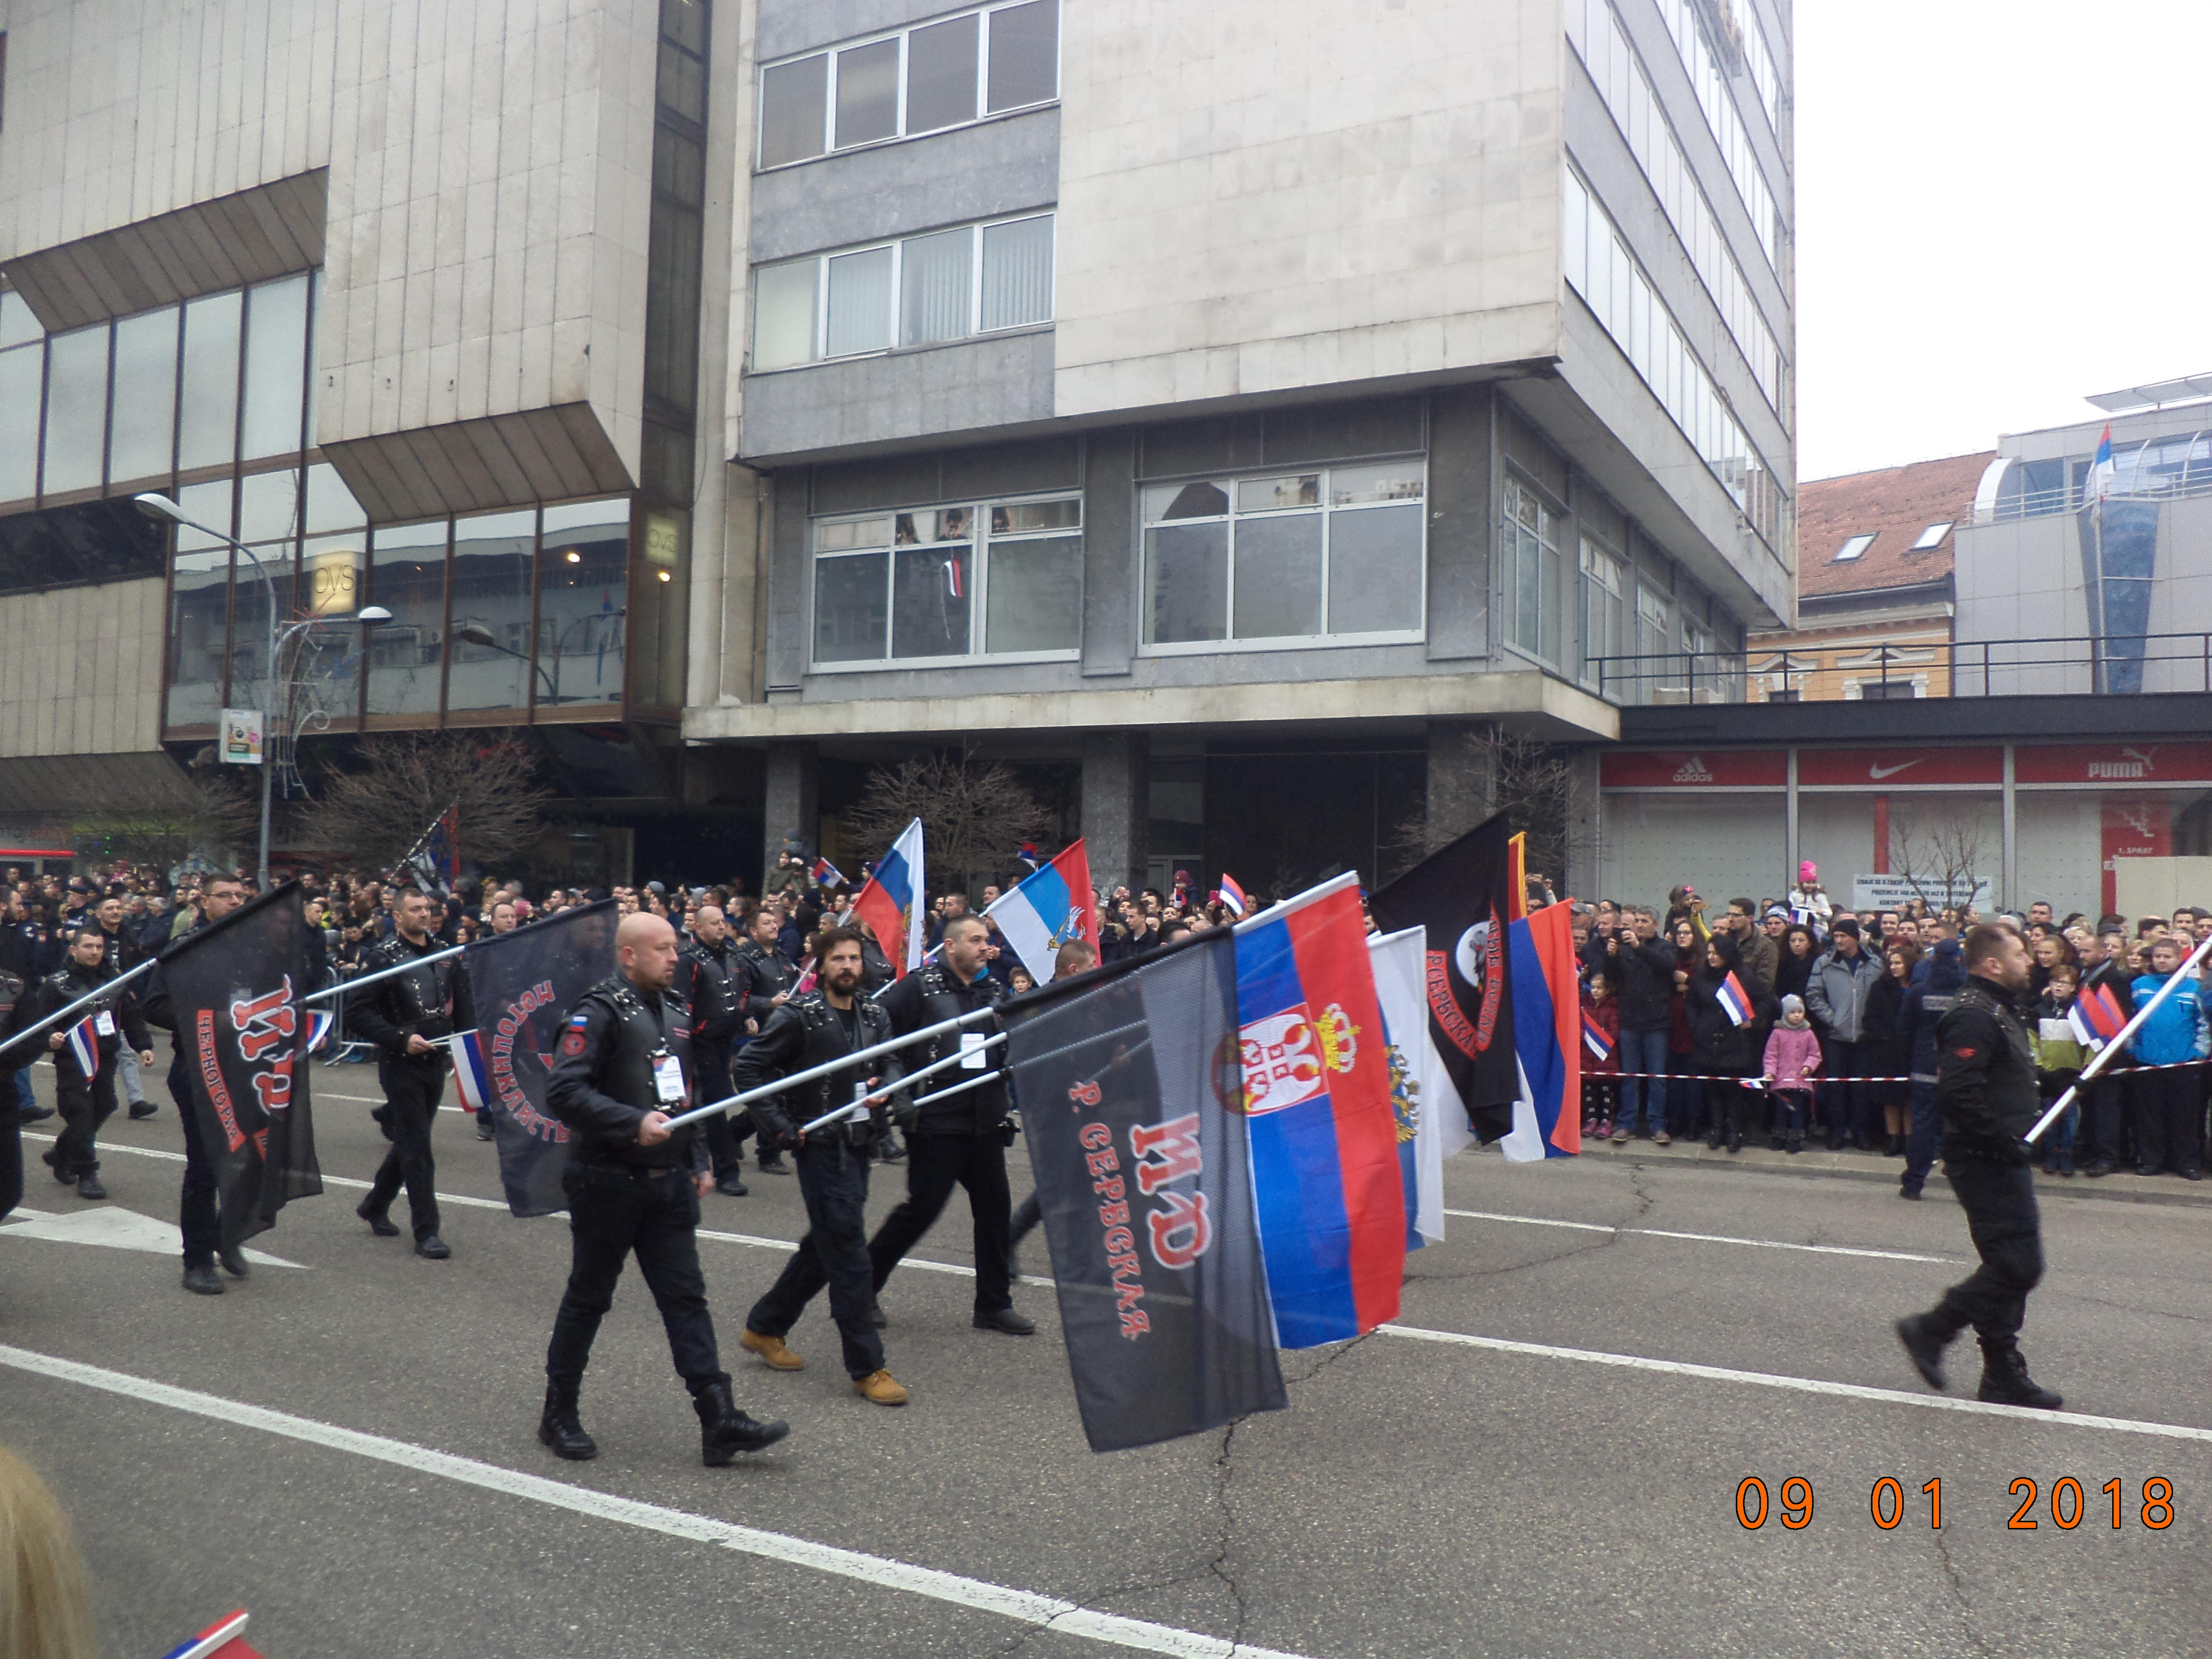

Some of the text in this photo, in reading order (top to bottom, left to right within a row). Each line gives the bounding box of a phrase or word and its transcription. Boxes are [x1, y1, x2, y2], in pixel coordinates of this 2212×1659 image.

[314, 565, 354, 593] OVS
[1673, 772, 1713, 782] adidas
[2089, 762, 2143, 778] PUMA
